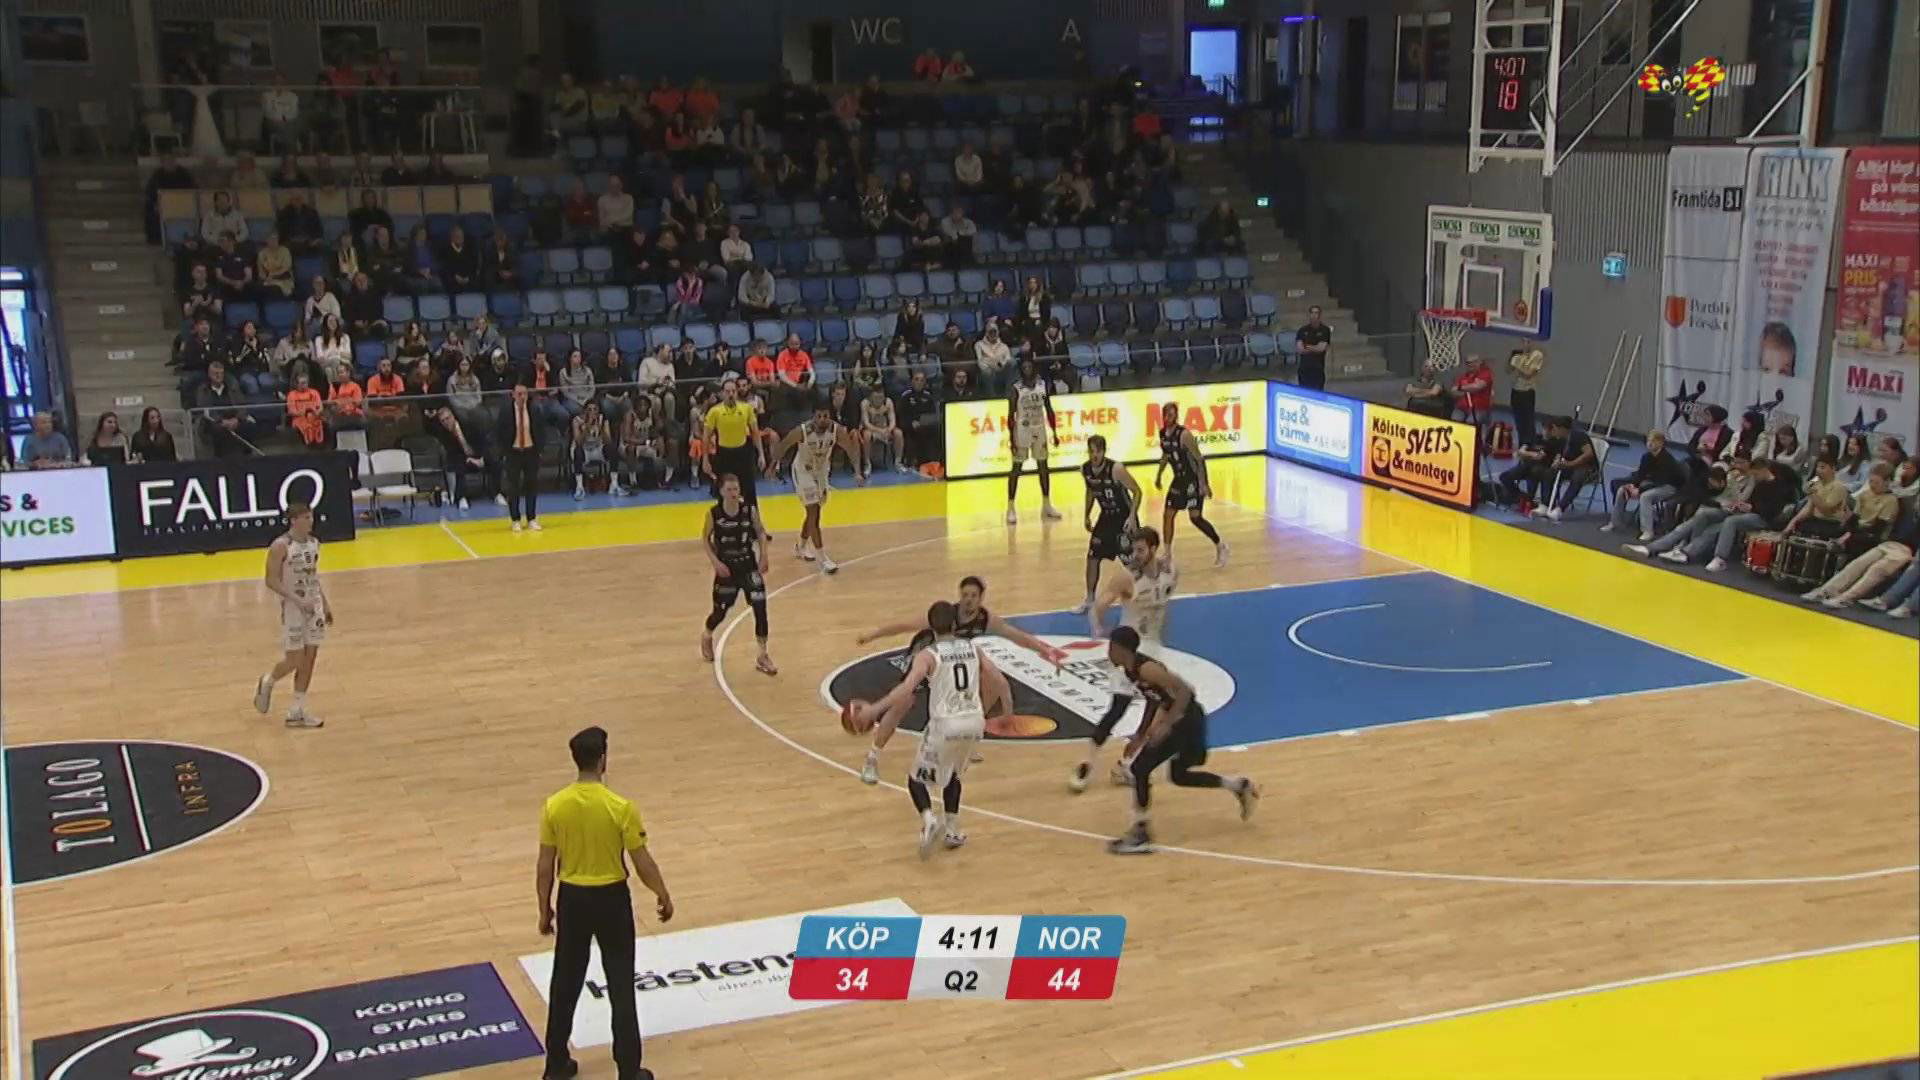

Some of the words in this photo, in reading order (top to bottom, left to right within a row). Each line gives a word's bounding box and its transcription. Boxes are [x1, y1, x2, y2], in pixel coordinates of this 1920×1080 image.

[851, 18, 901, 44] WC
[1061, 18, 1082, 43] A
[1494, 57, 1526, 76] 4:07
[1498, 81, 1519, 110] 18
[1671, 188, 1721, 208] Framtida
[1845, 254, 1879, 268] MAXI
[969, 410, 995, 435] SÅ
[1080, 407, 1118, 426] MER
[1299, 404, 1310, 426] &
[1405, 425, 1453, 456] SVETS
[21, 493, 39, 511] &
[138, 468, 325, 527] FALLO
[953, 663, 969, 692] 0
[174, 759, 210, 816] INFRA
[46, 757, 116, 852] TOLAGO
[354, 991, 466, 1018] KÖPING
[371, 1010, 467, 1035] STARS
[334, 1020, 521, 1062] BARBERARE
